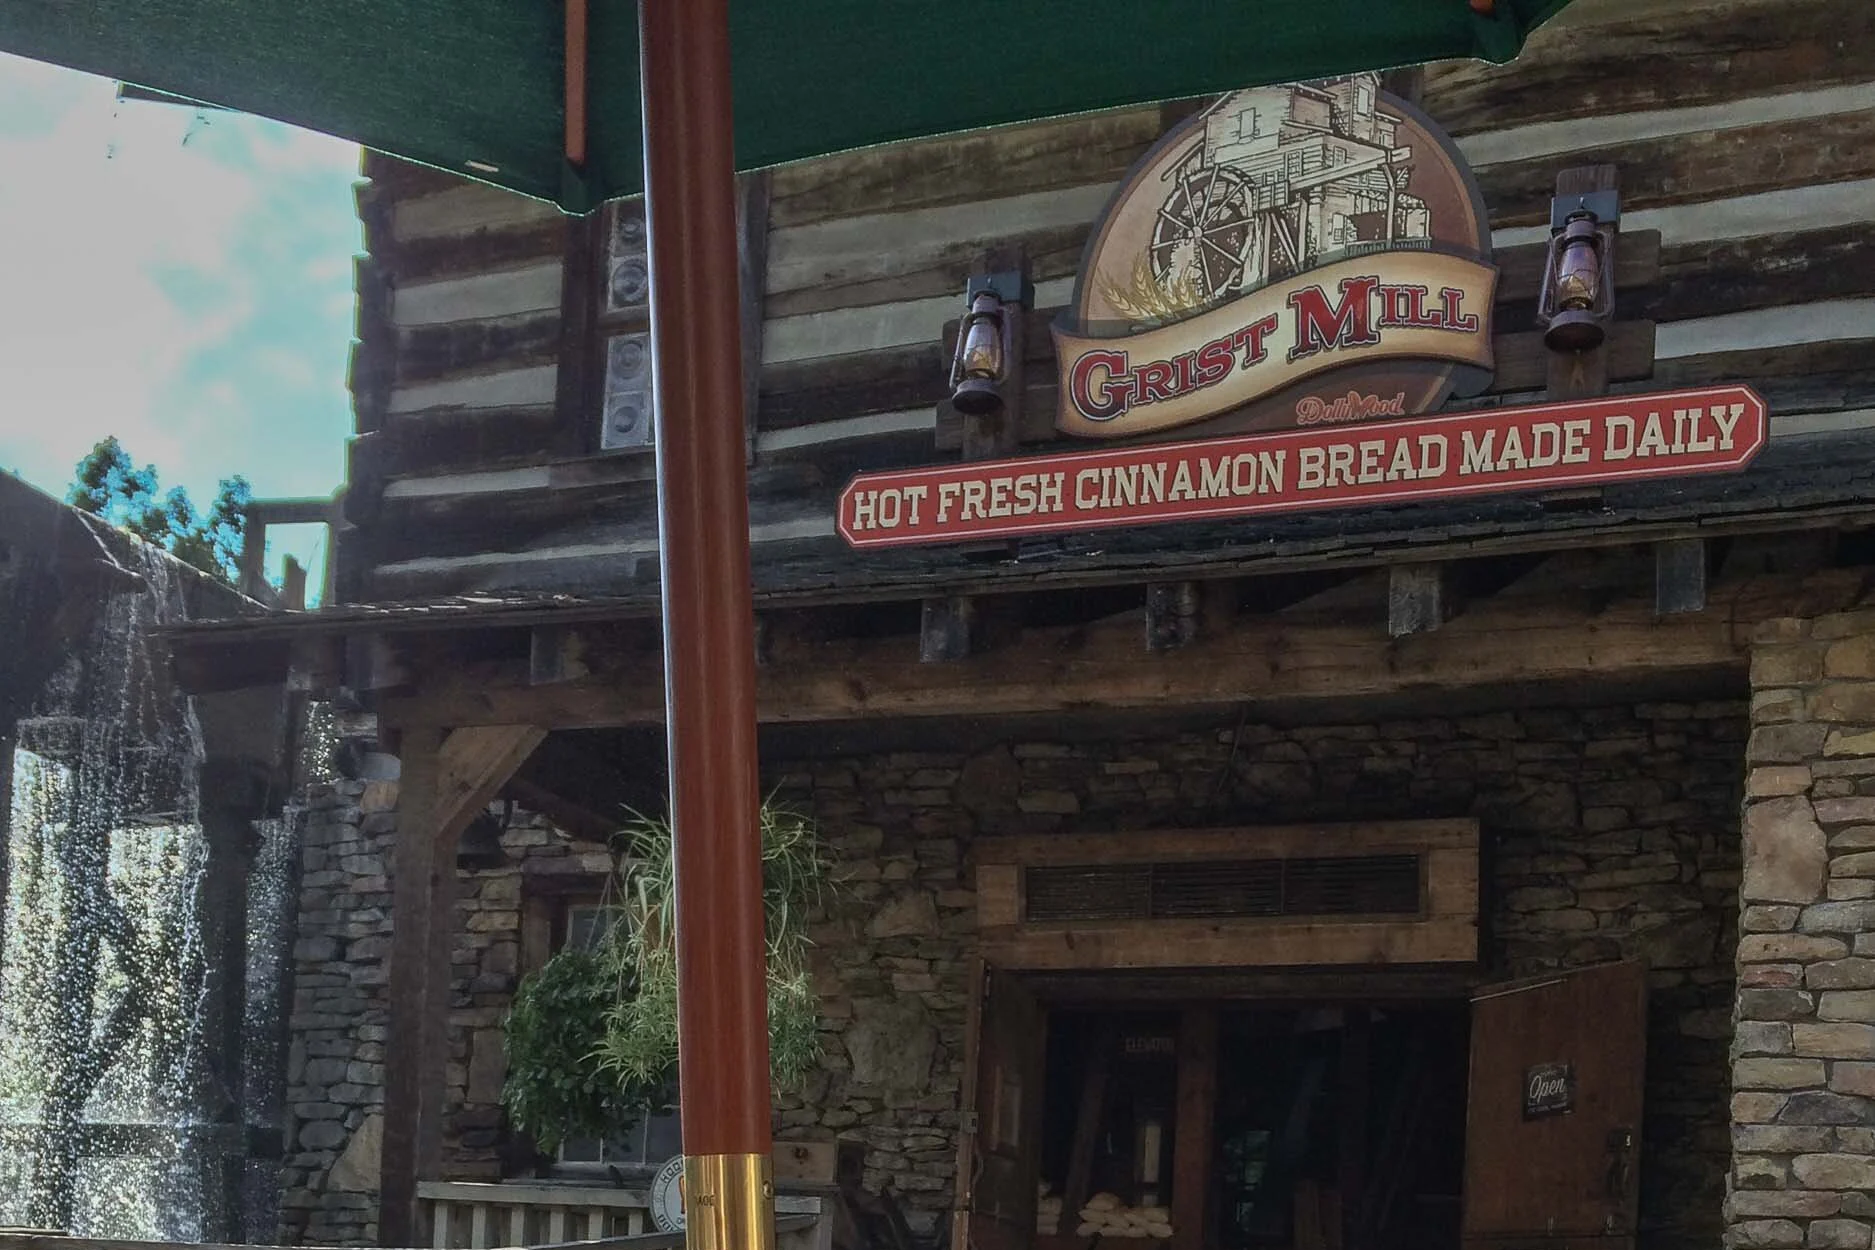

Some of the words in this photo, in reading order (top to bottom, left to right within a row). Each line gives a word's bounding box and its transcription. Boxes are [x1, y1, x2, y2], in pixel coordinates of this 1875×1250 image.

[852, 486, 928, 531] HOT
[936, 471, 1066, 523] FRESH
[1074, 450, 1287, 511] CINNAMON
[1296, 433, 1449, 490] BREAD
[1459, 419, 1592, 476] MADE
[1603, 403, 1745, 462] DAILY
[1529, 1075, 1565, 1104] Open
